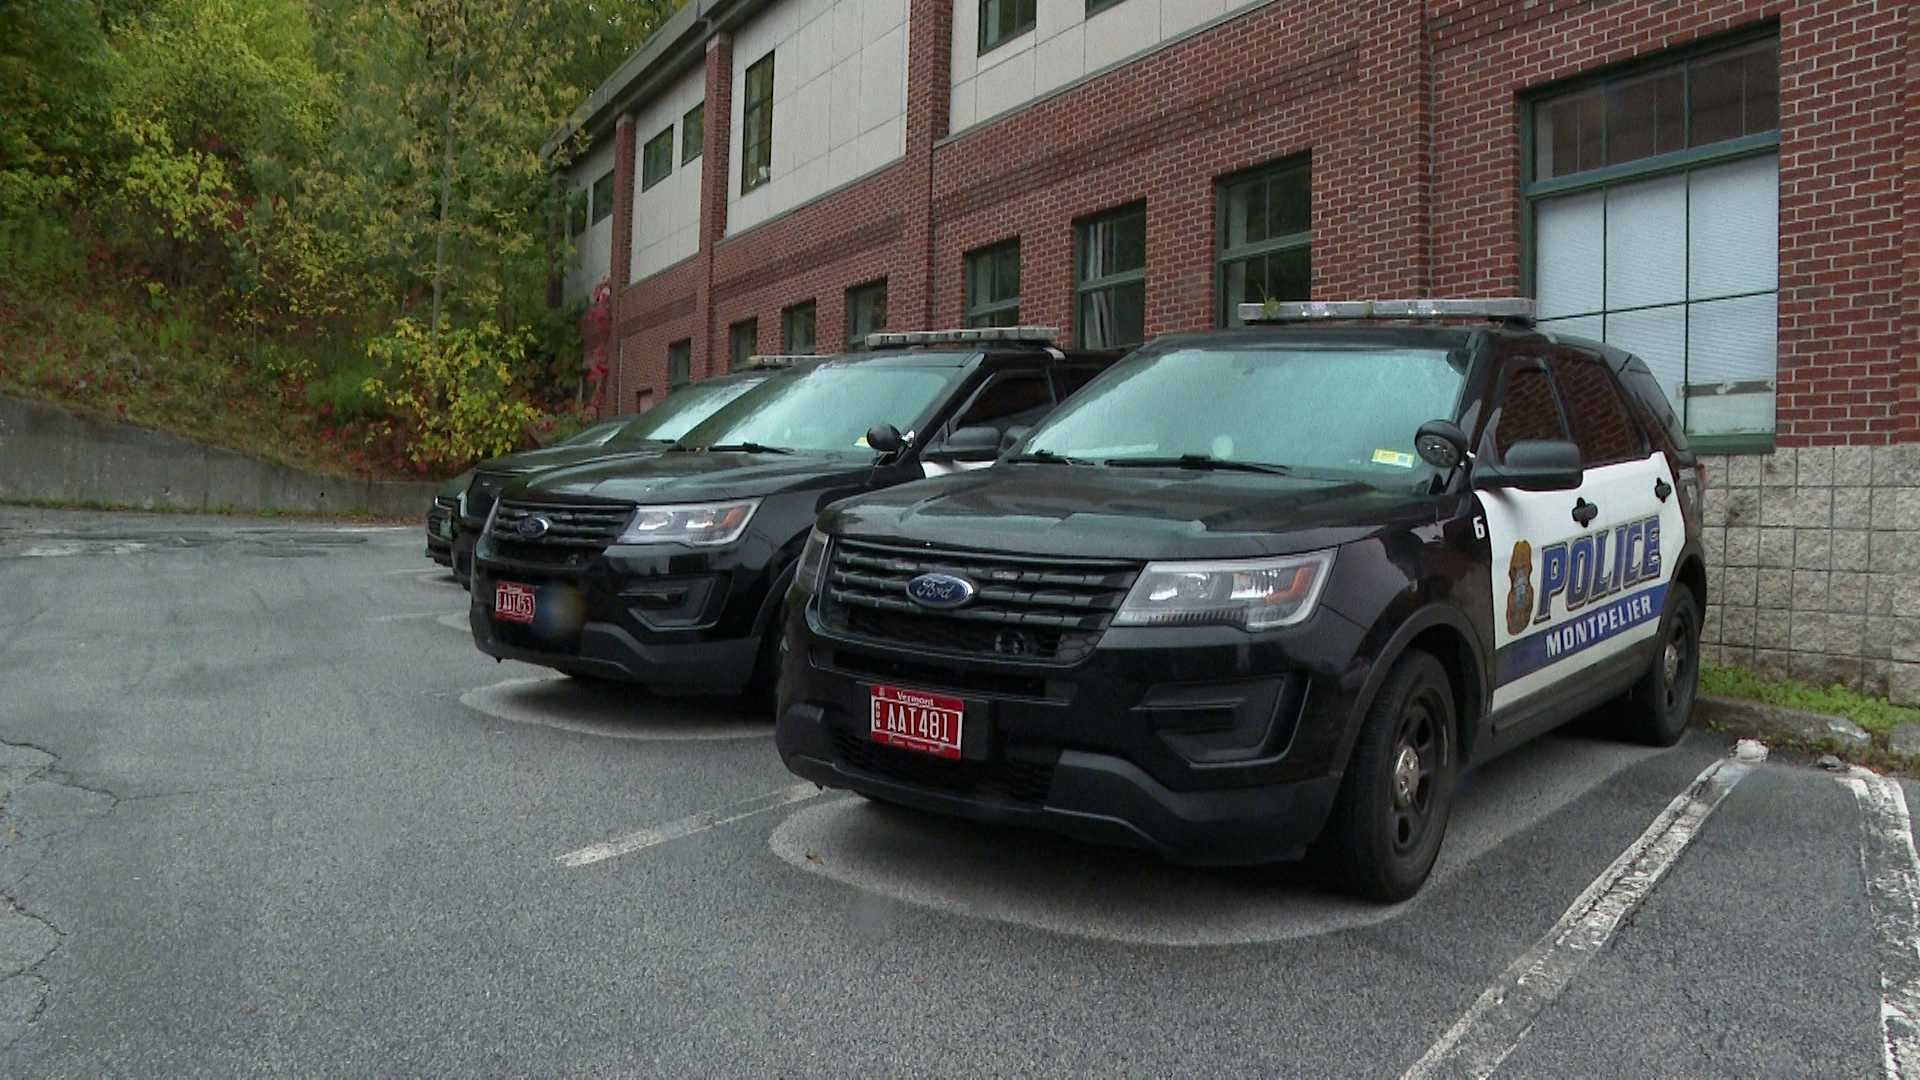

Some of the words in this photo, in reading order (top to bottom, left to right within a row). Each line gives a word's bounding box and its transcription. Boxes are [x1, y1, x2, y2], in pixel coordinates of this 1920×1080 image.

[1472, 515, 1486, 539] 6
[1533, 514, 1661, 625] POLICE
[916, 580, 956, 600] Ford
[1546, 595, 1652, 658] MONTPELIER
[896, 689, 934, 706] Vermont
[886, 703, 950, 743] AAT481
